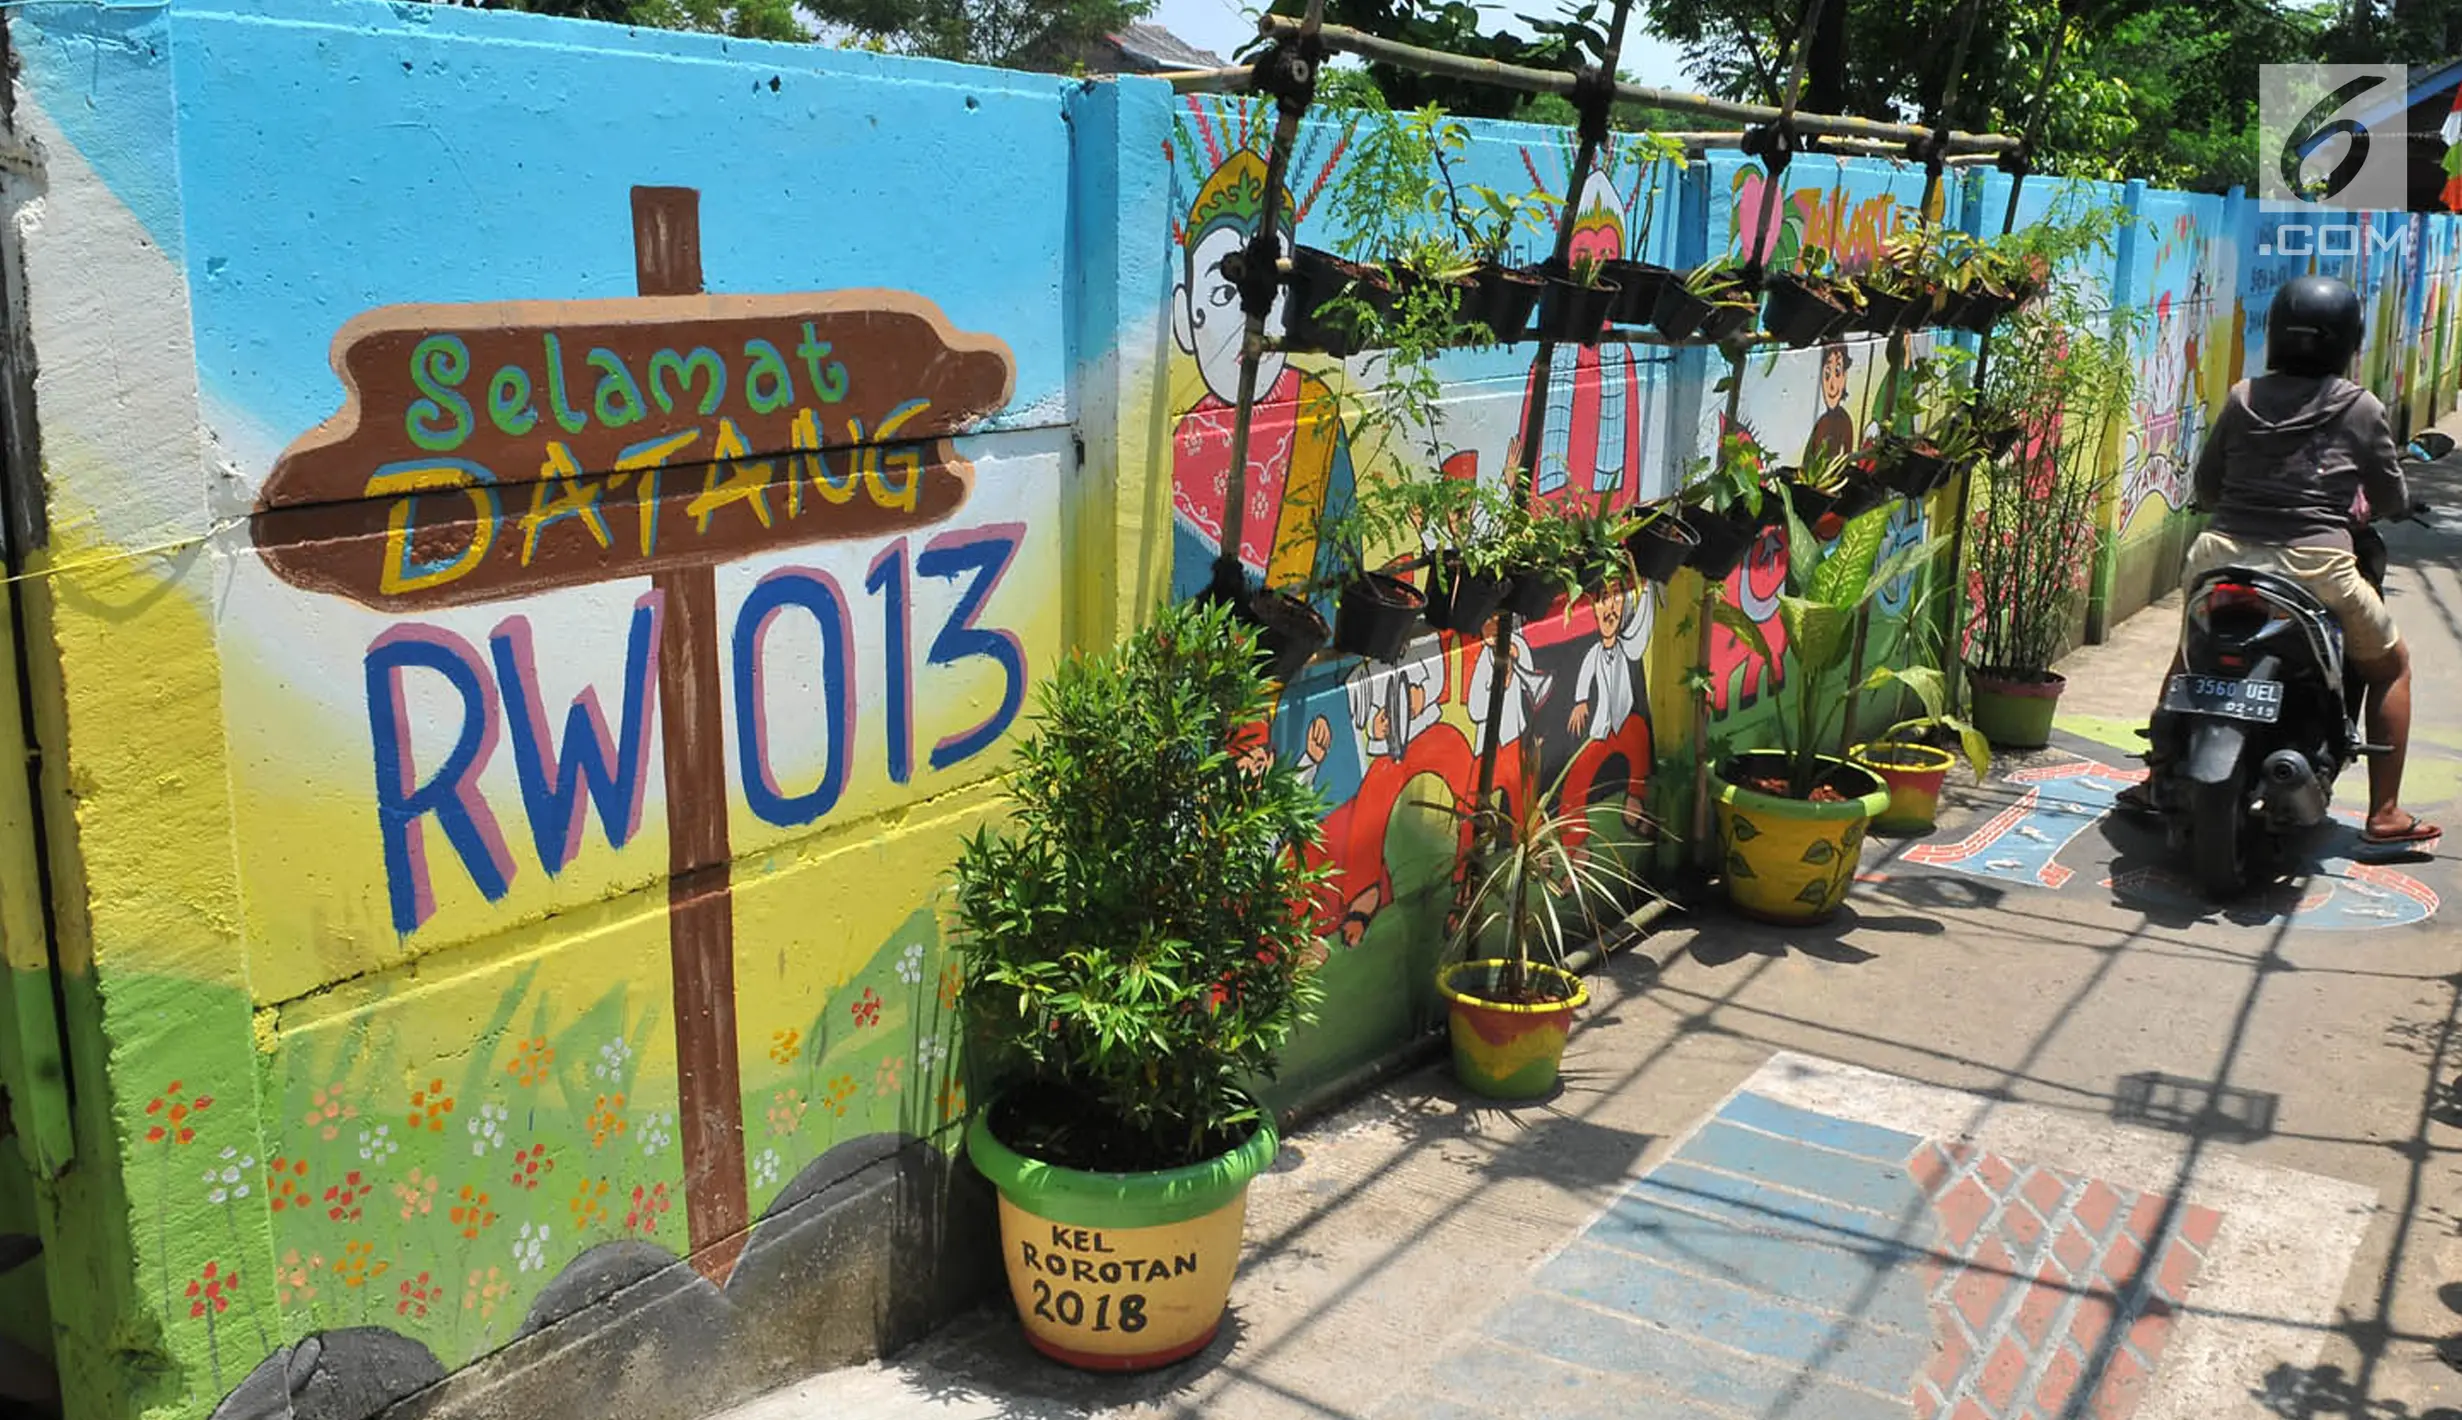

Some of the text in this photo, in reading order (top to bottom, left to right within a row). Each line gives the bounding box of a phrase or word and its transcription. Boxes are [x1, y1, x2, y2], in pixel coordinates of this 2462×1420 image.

[405, 322, 848, 452] Selamat
[363, 399, 931, 595] DATANG
[2195, 679, 2237, 698] 3560
[2245, 683, 2278, 703] UEL
[363, 522, 1028, 938] RW 013
[1020, 1240, 1198, 1284] ROROTAN
[1052, 1225, 1115, 1254] KEL
[1031, 1278, 1148, 1333] 2018
